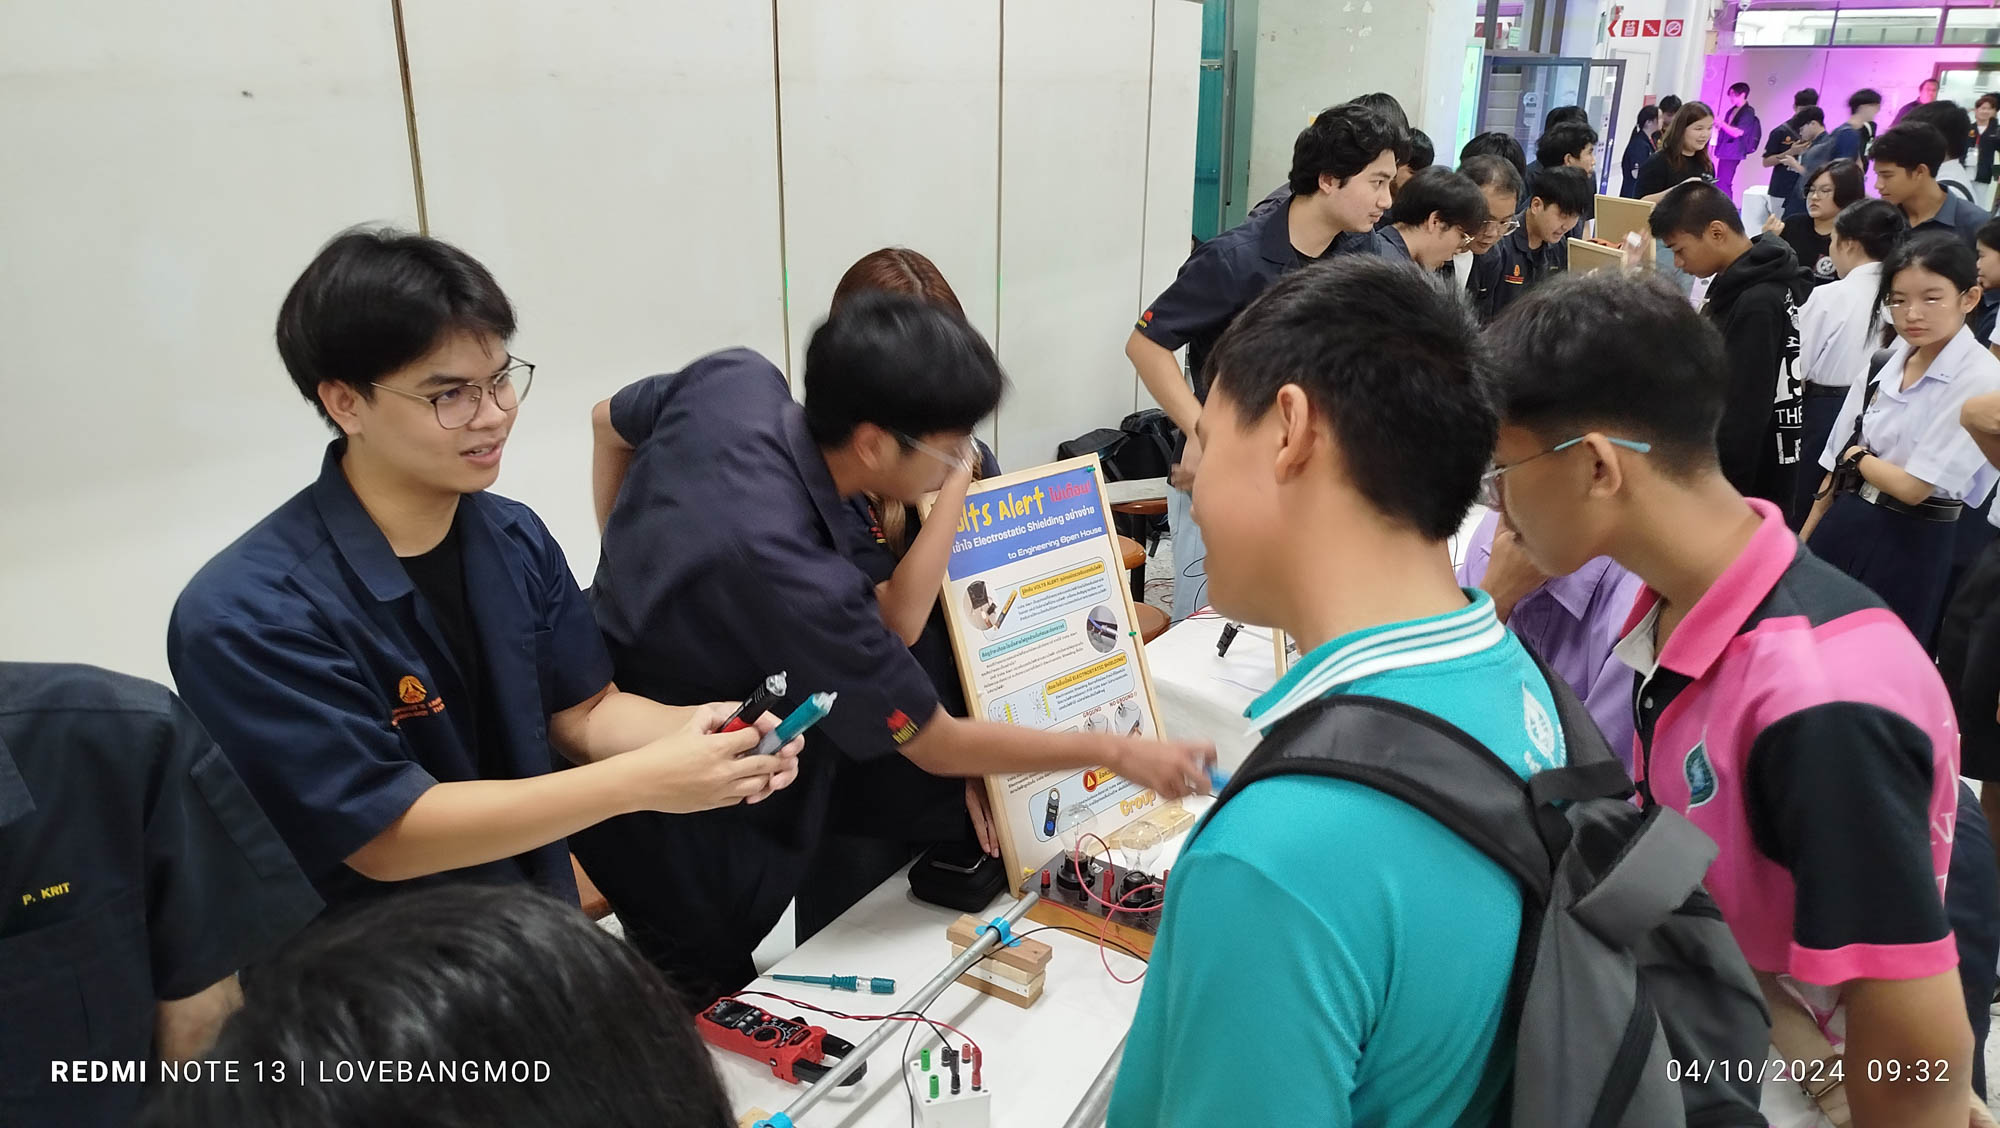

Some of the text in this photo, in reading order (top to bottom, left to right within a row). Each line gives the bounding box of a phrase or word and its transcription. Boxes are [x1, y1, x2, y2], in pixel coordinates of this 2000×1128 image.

[998, 485, 1045, 521] Alert
[973, 525, 1027, 548] Electrostatic
[1027, 515, 1065, 532] Shielding
[1007, 552, 1018, 560] to
[1017, 539, 1060, 557] Engineering
[1080, 526, 1103, 538] House
[1082, 706, 1102, 718] GROUND
[1120, 788, 1156, 817] Group
[22, 881, 71, 906] P. KRIT
